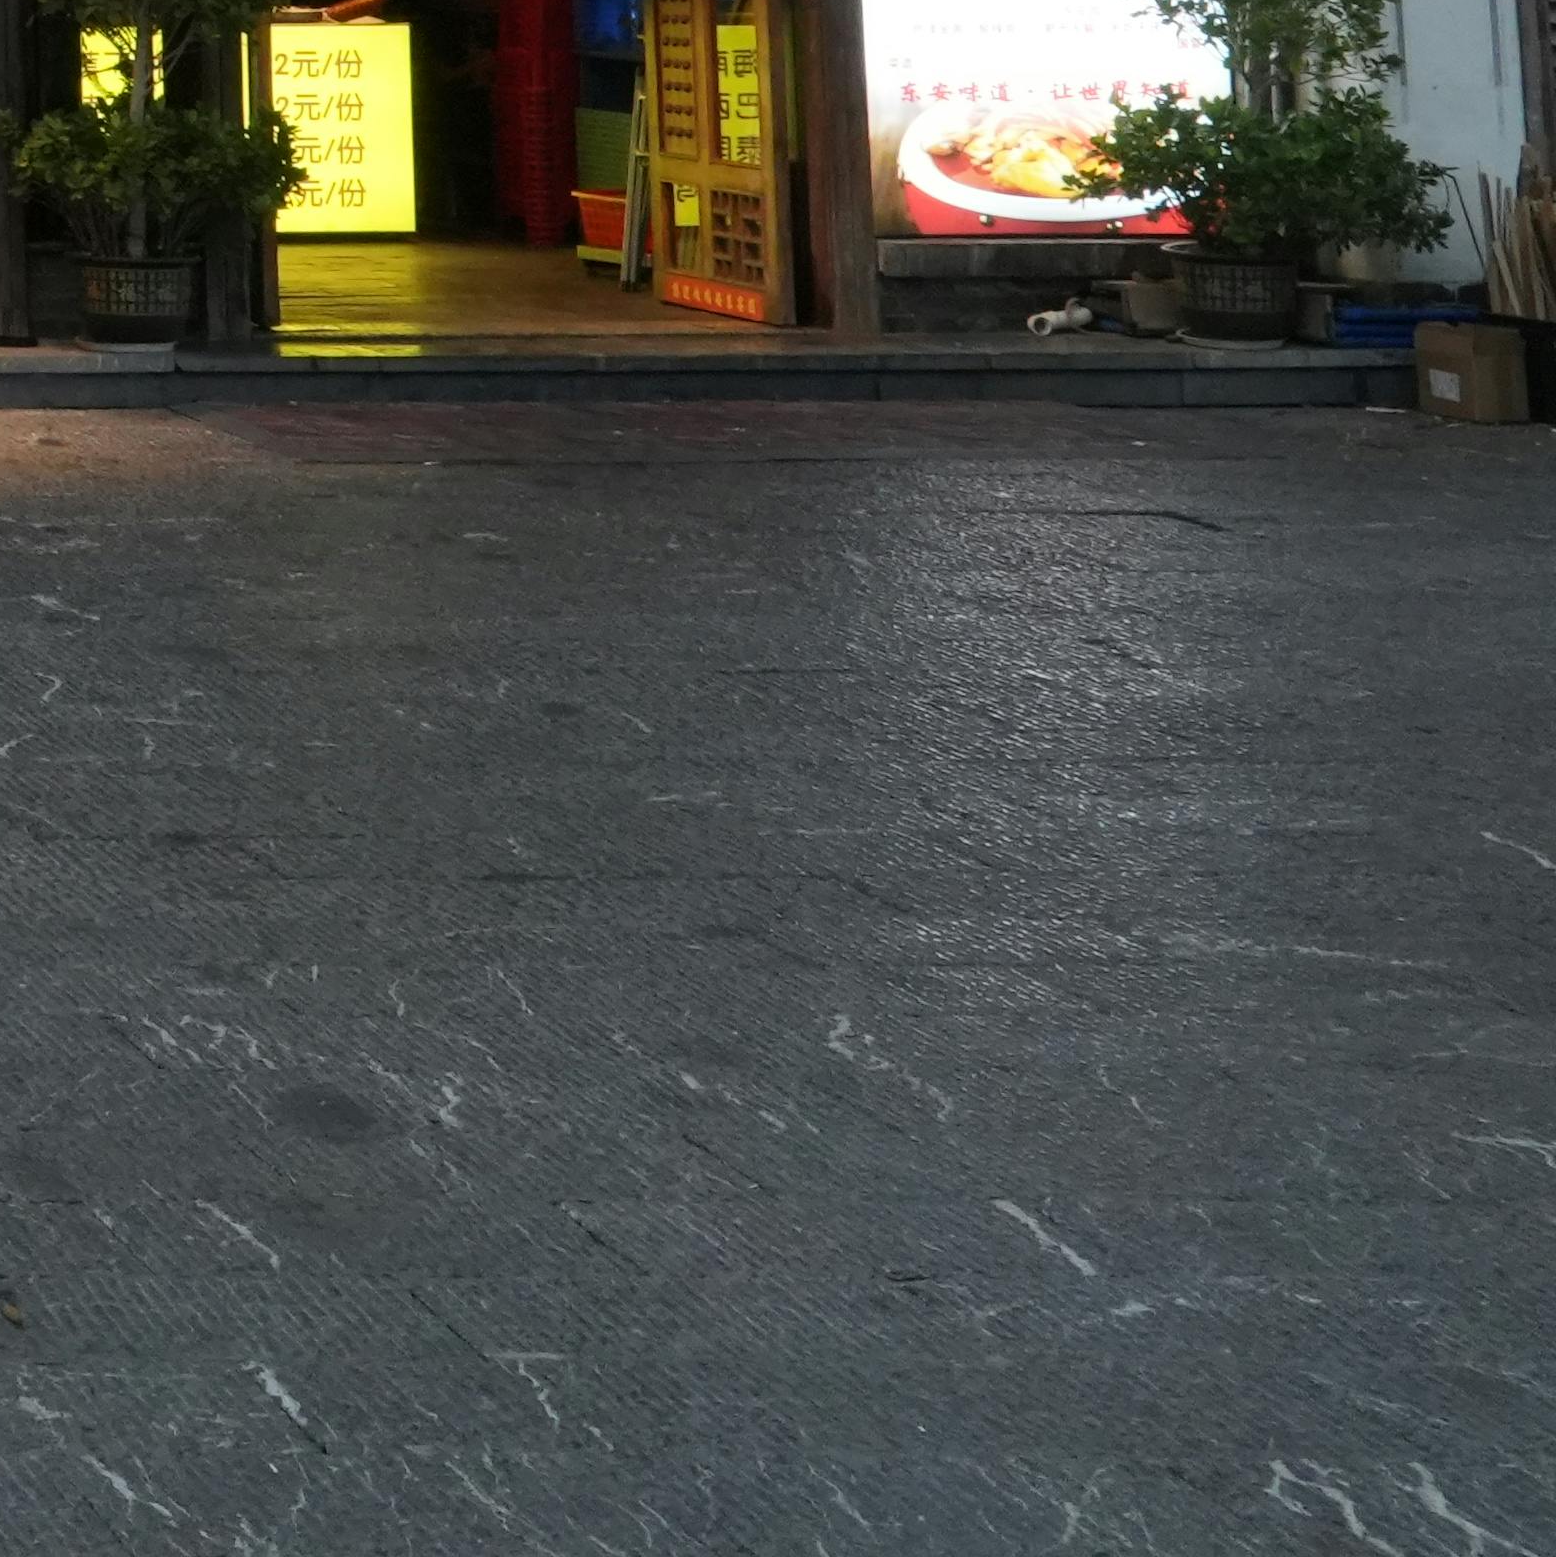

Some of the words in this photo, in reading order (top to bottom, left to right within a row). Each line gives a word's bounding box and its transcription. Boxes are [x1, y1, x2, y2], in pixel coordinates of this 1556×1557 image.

[275, 50, 362, 79] 2元/份
[292, 136, 365, 164] 元/份
[290, 179, 366, 208] 元/份
